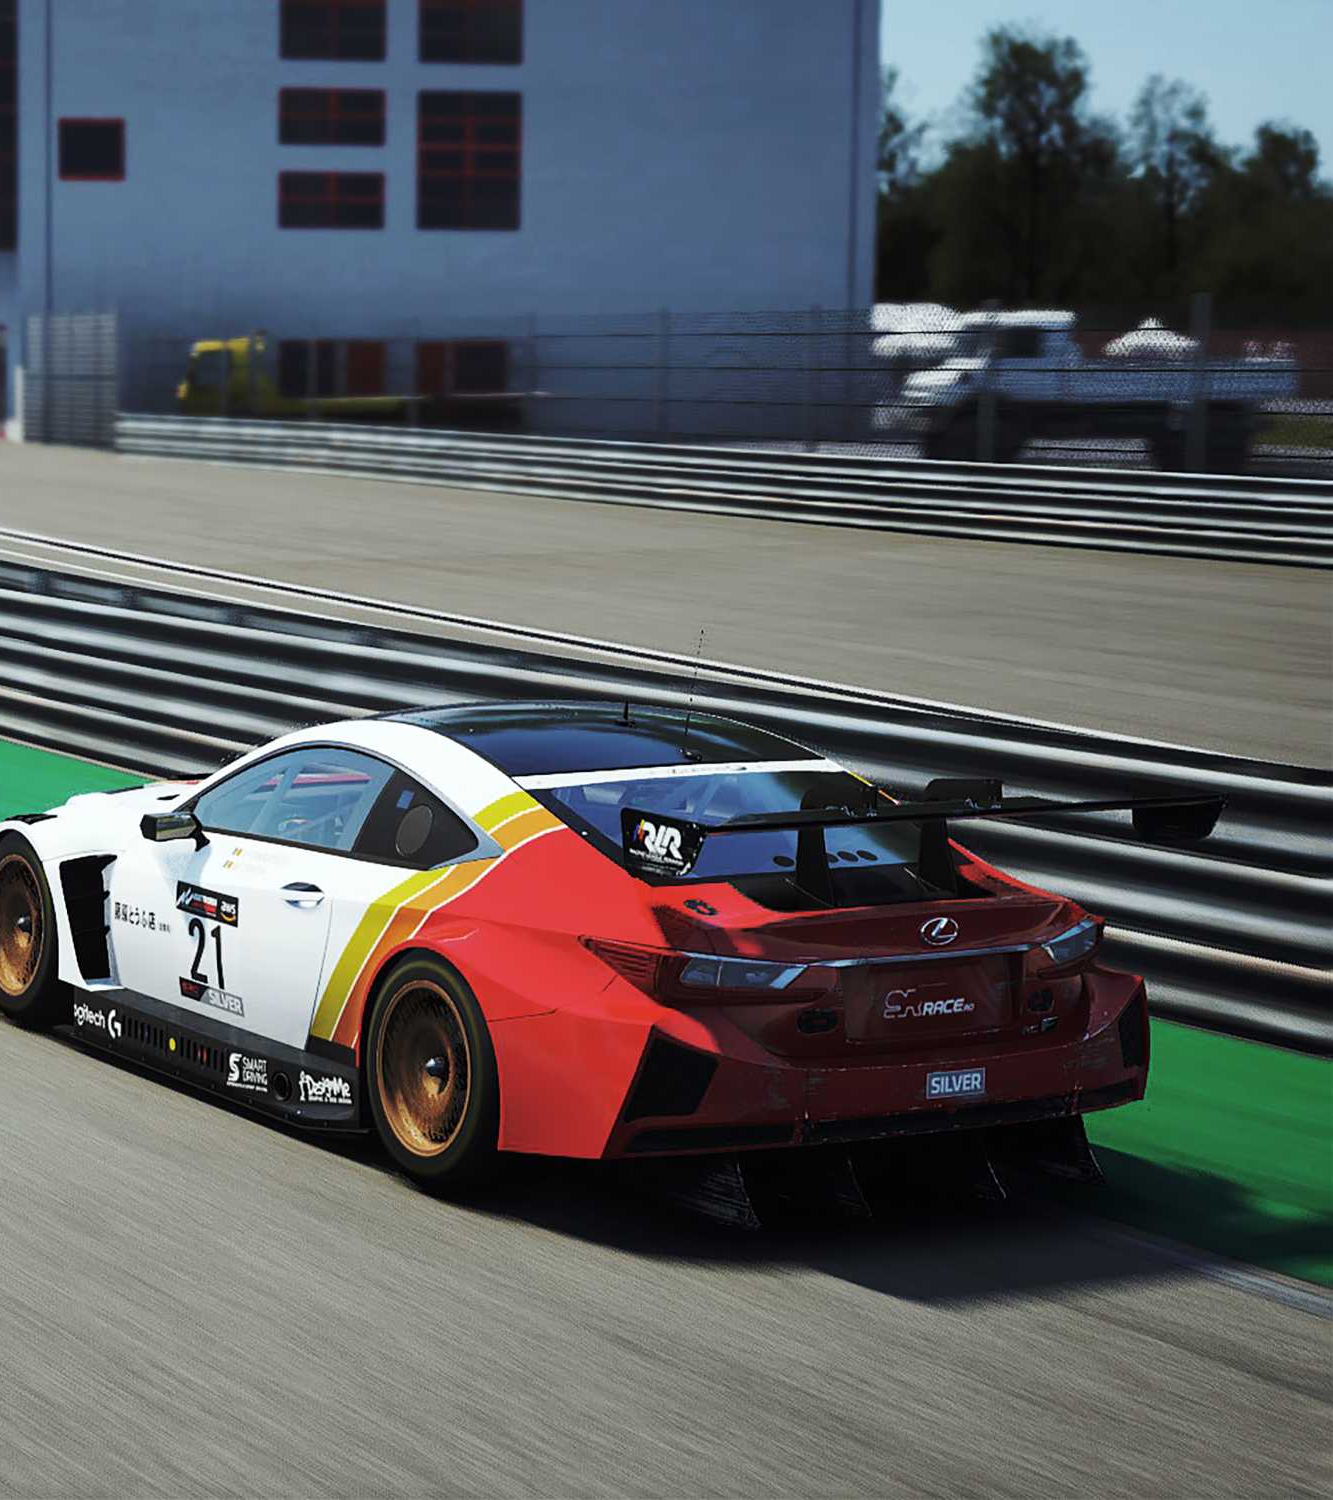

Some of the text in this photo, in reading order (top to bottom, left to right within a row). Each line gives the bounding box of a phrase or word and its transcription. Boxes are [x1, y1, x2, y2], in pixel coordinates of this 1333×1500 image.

[188, 917, 225, 991] 21
[207, 989, 243, 1015] SILVER
[242, 1056, 267, 1073] SMART
[930, 1072, 982, 1094] SILVER
